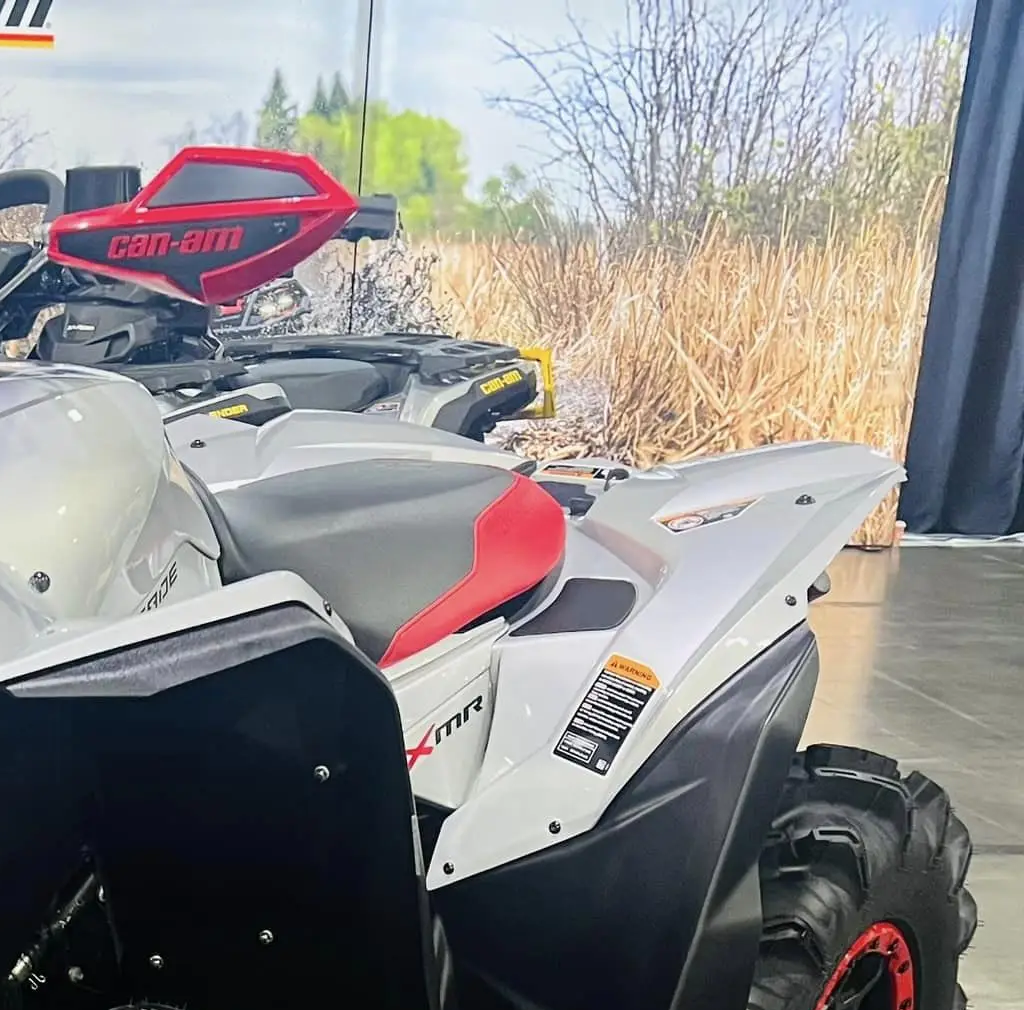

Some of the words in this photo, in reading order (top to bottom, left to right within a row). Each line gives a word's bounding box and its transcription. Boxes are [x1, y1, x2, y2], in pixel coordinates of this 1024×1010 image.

[107, 226, 244, 260] can-am
[479, 370, 522, 395] can-am
[618, 663, 653, 681] WARNING
